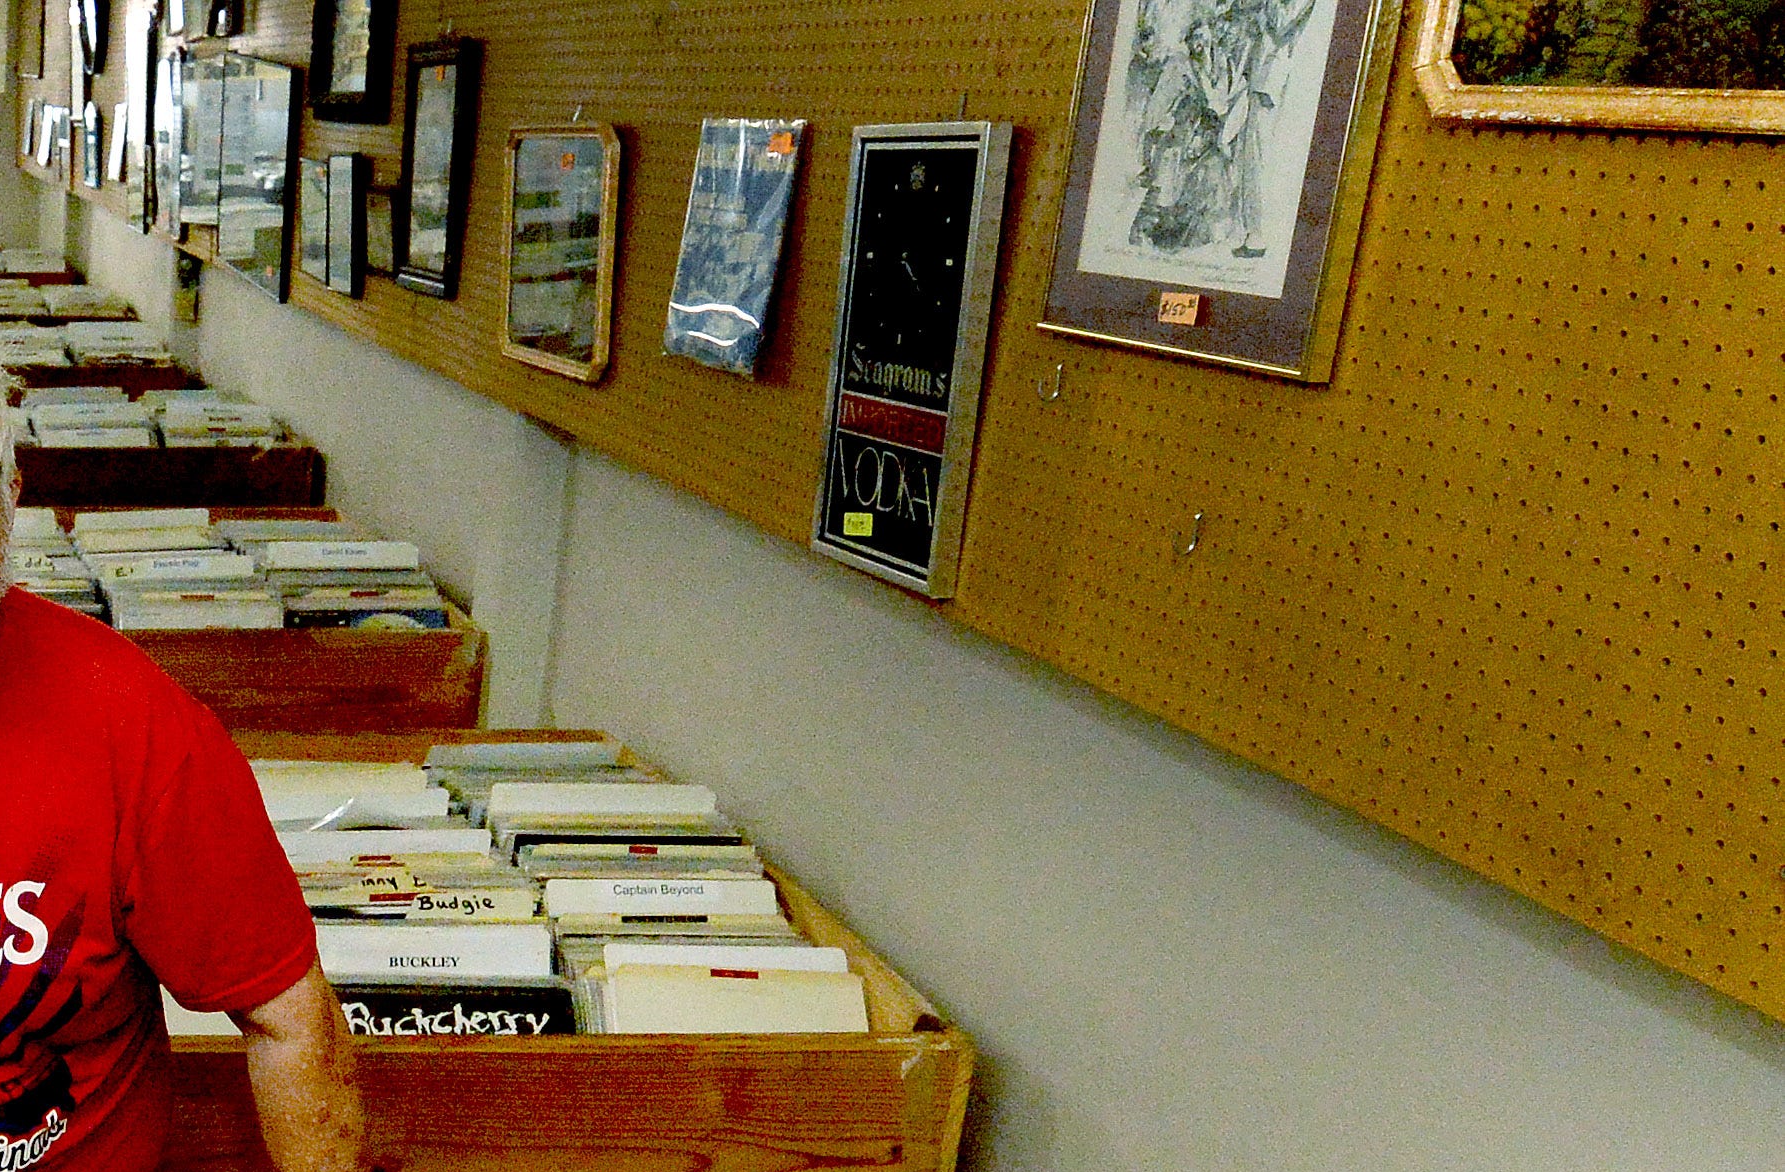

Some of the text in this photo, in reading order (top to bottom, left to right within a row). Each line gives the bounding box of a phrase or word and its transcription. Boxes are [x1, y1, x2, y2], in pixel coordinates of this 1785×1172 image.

[838, 438, 934, 527] VODKA
[613, 883, 705, 897] Captain Beyond
[416, 894, 496, 916] Budgie
[388, 956, 461, 968] BUCKLEY
